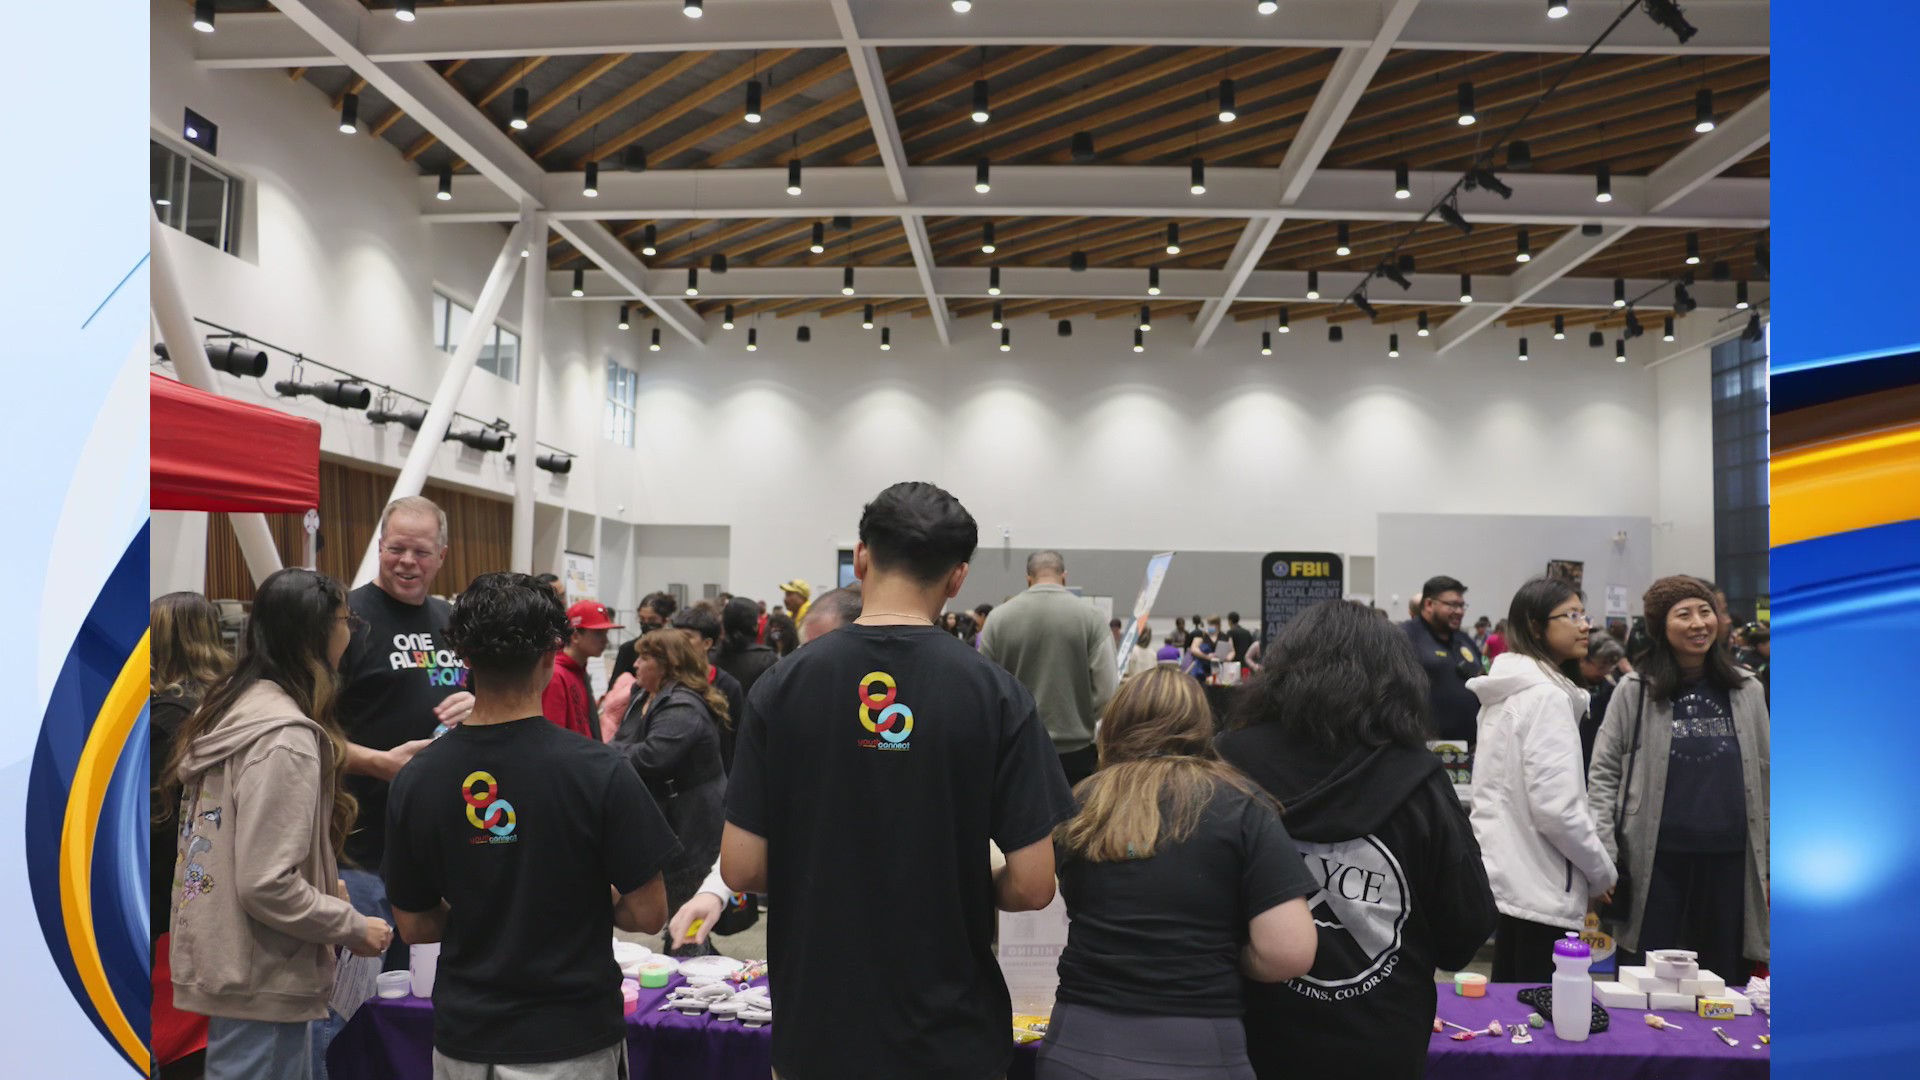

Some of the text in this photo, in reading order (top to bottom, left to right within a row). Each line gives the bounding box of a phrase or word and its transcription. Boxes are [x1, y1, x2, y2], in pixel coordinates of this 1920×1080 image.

[1290, 561, 1322, 577] FBI
[1265, 588, 1340, 598] SPECIAL AGENT
[392, 632, 435, 651] ONE
[1334, 954, 1400, 1001] COLORADO
